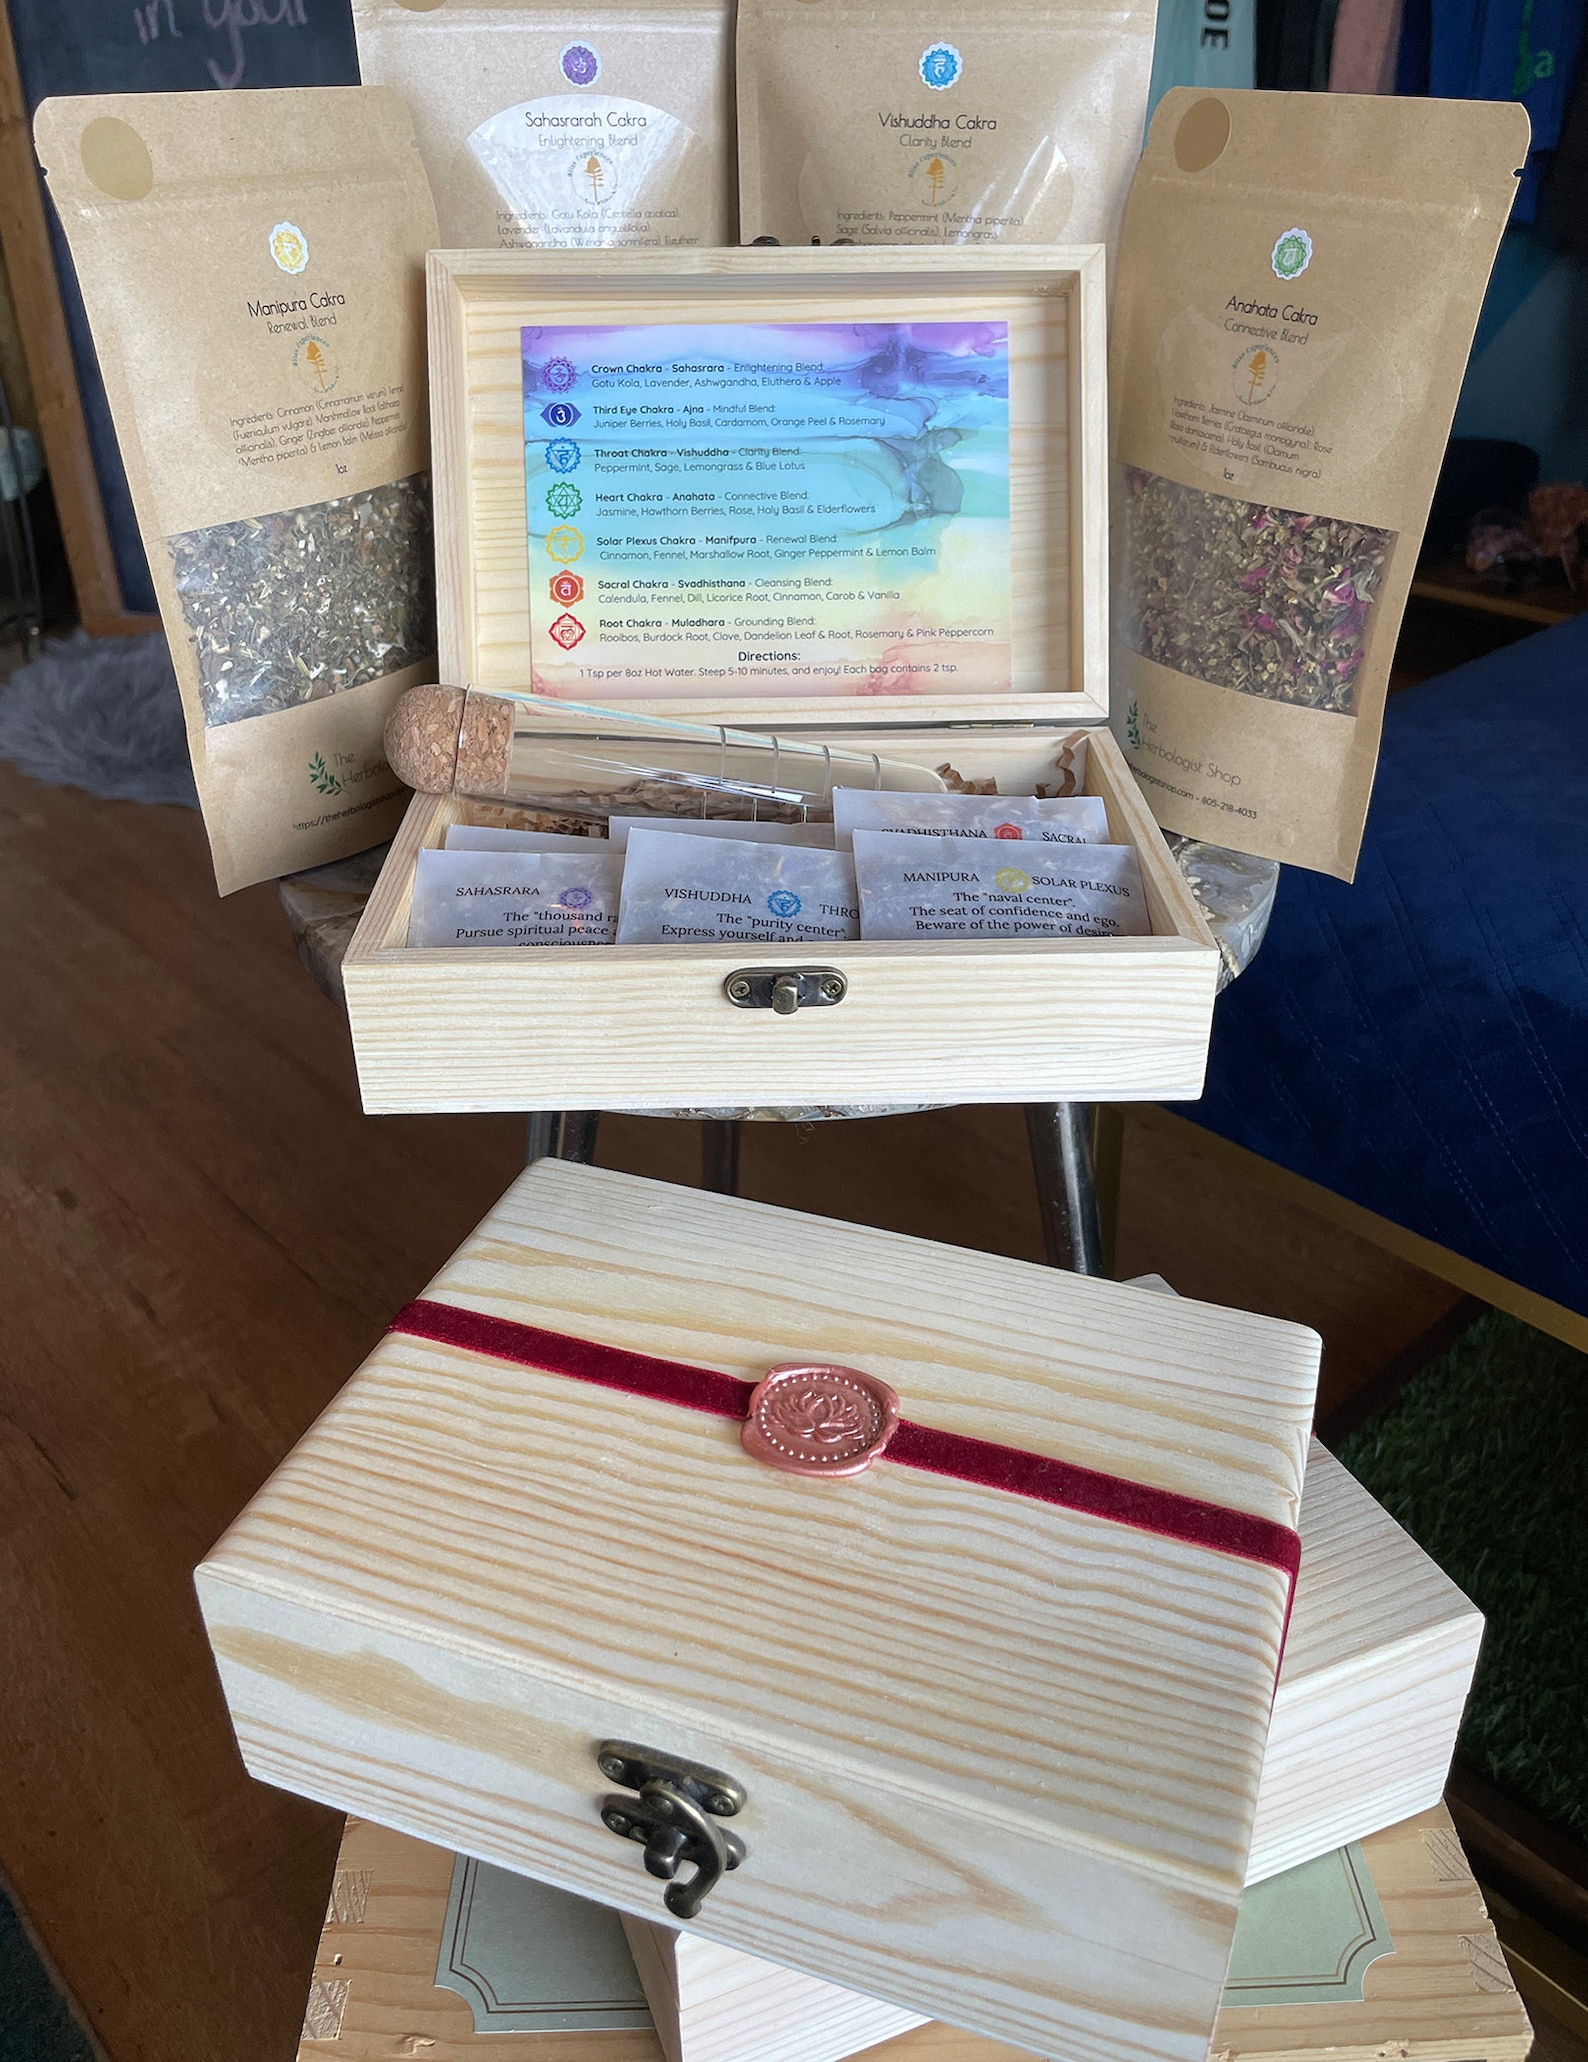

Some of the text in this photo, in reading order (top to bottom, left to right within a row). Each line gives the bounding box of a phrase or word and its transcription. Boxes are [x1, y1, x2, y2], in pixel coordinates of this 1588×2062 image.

[525, 112, 646, 127] Sahasrarah Cakra
[879, 113, 996, 130] Vishuddha Cakra
[539, 134, 637, 148] Enlightening Blend
[900, 134, 972, 148] Clarity Blend
[247, 292, 345, 318] Manipura Cakra
[1226, 296, 1318, 325] Anahata Cakra
[267, 313, 337, 334] Renewal Blend
[1224, 318, 1309, 345] Connective Blend
[592, 363, 824, 373] Crown Chakra Sahasrara Enlightening Blend:
[592, 379, 616, 388] Gotu
[618, 379, 642, 388] Kola,
[645, 379, 692, 388] Lavender,
[804, 378, 811, 386] &
[814, 377, 841, 387] Apple
[594, 405, 776, 416] Third Eye Chakra Ajna Mindful Blend:
[595, 448, 800, 458] Throat Chakra Vishuddha Clarity Blend:
[595, 462, 805, 474] Peppermint, Sage, Lemongrass & Blue Lotus
[596, 491, 808, 501] Heart Chakra Anahata Connective Blend:
[626, 537, 657, 545] Plexus
[660, 536, 696, 545] Chakra
[706, 536, 756, 547] Manifpura
[766, 535, 806, 543] Renewal
[810, 535, 839, 543] Blend:
[600, 551, 651, 560] Cinnamon,
[654, 551, 687, 560] Fennel,
[747, 550, 772, 559] Root,
[775, 550, 806, 559] Ginger
[809, 549, 863, 558] Peppermint
[876, 548, 908, 556] Lemon
[912, 548, 936, 556] Balm
[598, 578, 832, 589] Sacral Chakra Svadhisthana Cleansing Blend:
[600, 617, 815, 628] Root Chakra Muladhara Grounding Blend:
[600, 628, 993, 643] Rooibos, Burdock Root, Clove, Dandelion Leaf & Root, Rosemary & Pink Peppercorn
[739, 652, 800, 661] Directions:
[587, 669, 604, 680] Tsp
[607, 670, 622, 679] per
[626, 669, 642, 677] 8oz
[645, 668, 662, 677] Hot
[665, 668, 696, 677] Water.
[699, 668, 725, 677] Steep
[728, 667, 747, 676] 5-10
[750, 667, 789, 677] minutes,
[792, 666, 810, 675] and
[813, 665, 841, 676] enjoy!
[844, 665, 866, 673] Each
[869, 664, 888, 675] bag
[891, 664, 930, 673] contains
[933, 664, 939, 672] 2
[942, 664, 958, 674] tsp.
[456, 886, 540, 896] SAHASRARA
[904, 872, 1130, 896] MANIPURA SOLAR PLEXUS
[665, 889, 752, 904] VISHUDDHA
[953, 892, 1075, 907] The "naval center".
[504, 911, 530, 921] The
[534, 911, 603, 921] "thousand
[910, 906, 1120, 928] The seat of confidence and ego.
[456, 925, 609, 939] Pursue spiritual peace
[662, 924, 714, 937] Express
[719, 929, 776, 942] yourself
[717, 913, 848, 939] The "purity center".
[916, 920, 966, 930] Beware
[970, 920, 984, 930] of
[988, 919, 1010, 930] the
[1014, 920, 1056, 933] power
[1060, 922, 1072, 933] of
